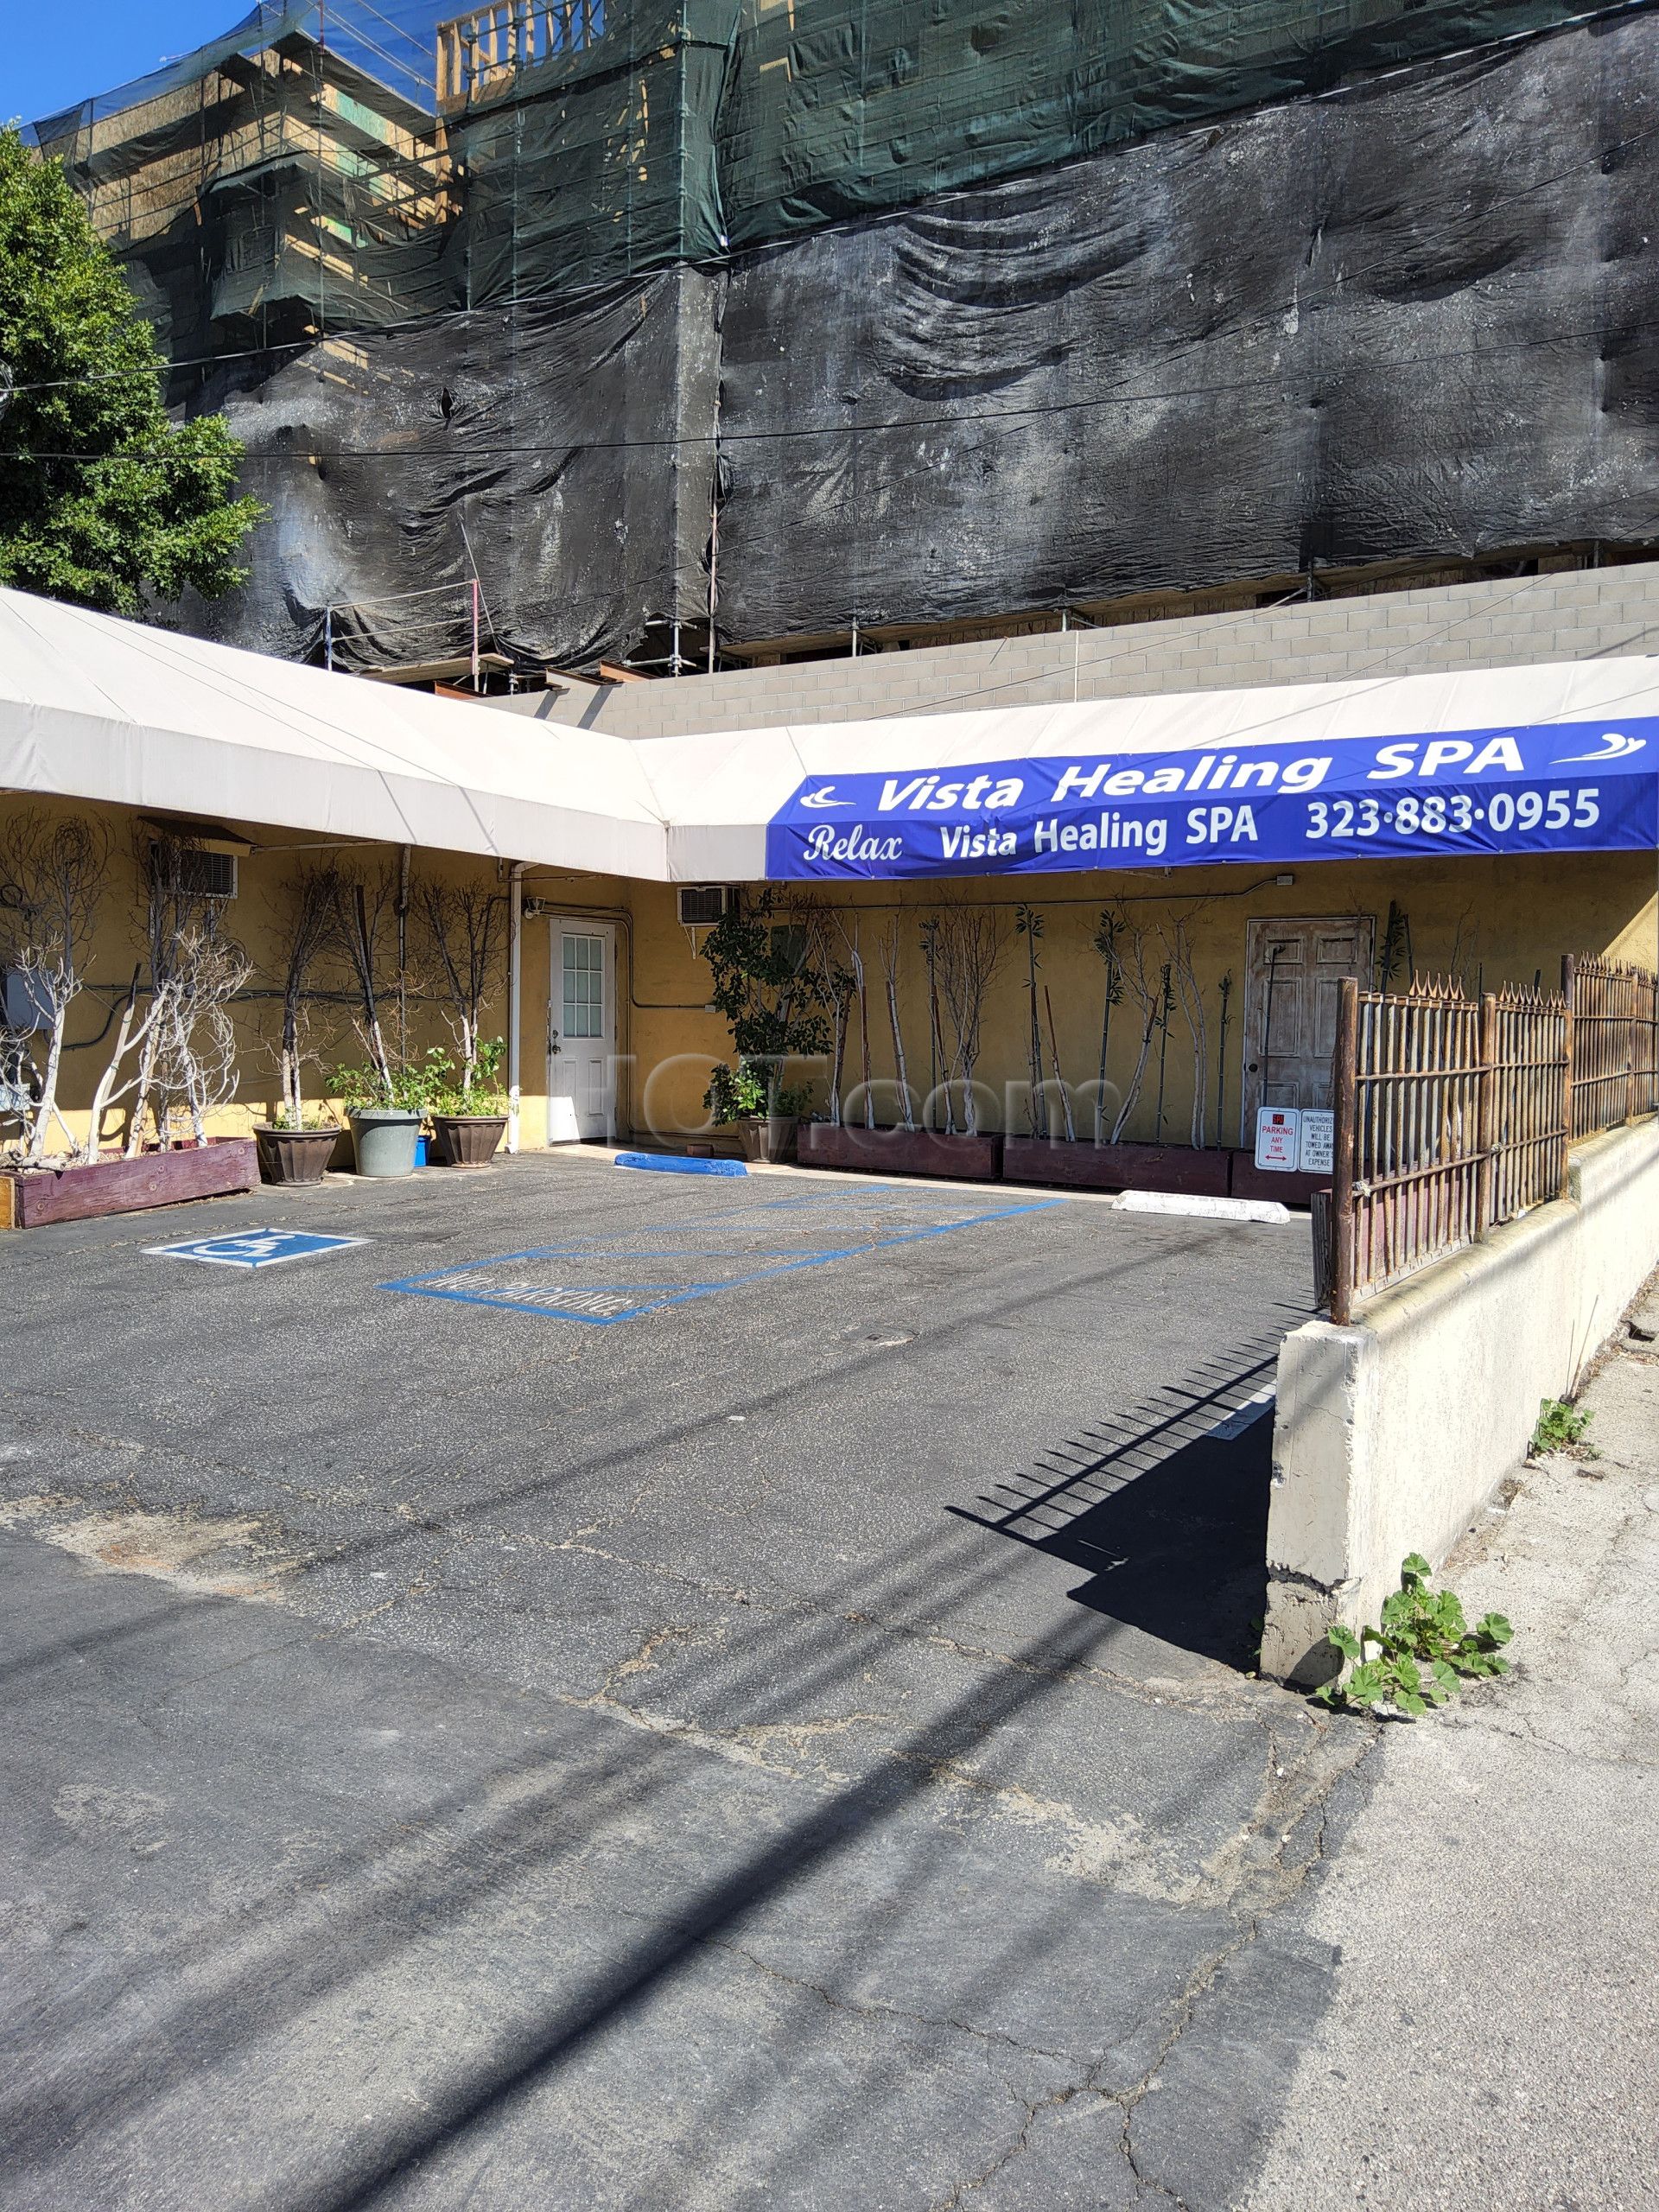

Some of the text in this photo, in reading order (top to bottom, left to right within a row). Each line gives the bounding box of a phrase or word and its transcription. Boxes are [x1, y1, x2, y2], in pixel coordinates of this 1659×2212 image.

[878, 737, 1525, 811] Vista Healing SPA
[803, 823, 903, 861] Relax
[939, 824, 1017, 858] Vista
[1033, 811, 1167, 856] Healing
[1185, 805, 1258, 844] SPA
[1303, 1116, 1333, 1124] UNAUTHORIZ
[1262, 1125, 1294, 1135] PARKING
[1309, 1124, 1333, 1133] VEHICLES
[1270, 1145, 1283, 1154] TIME
[1305, 1141, 1321, 1149] TOWED
[1308, 1158, 1331, 1166] EXPENSE
[426, 1273, 633, 1313] NO PARKING
